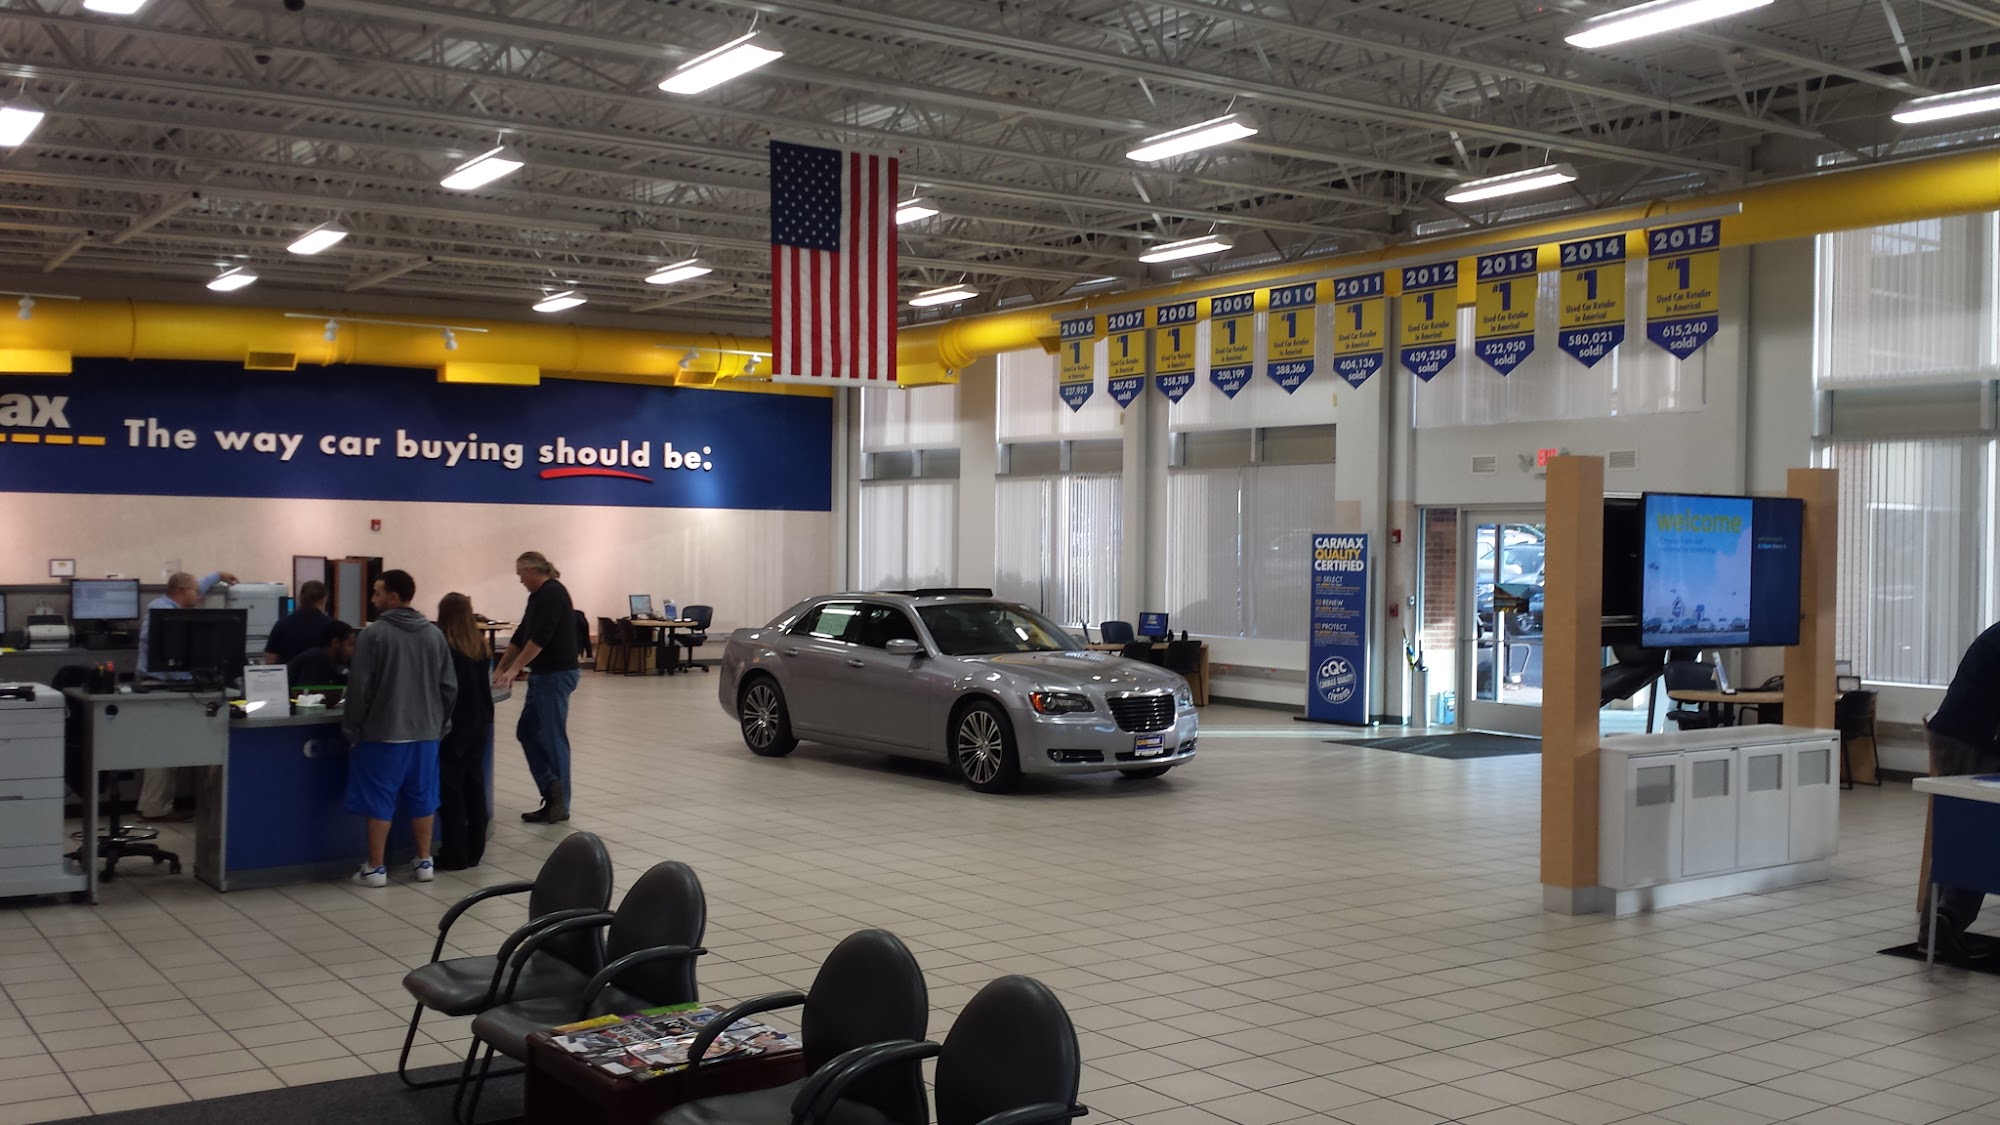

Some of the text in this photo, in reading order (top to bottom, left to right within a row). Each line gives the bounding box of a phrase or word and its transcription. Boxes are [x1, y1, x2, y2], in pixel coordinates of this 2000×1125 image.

[1654, 225, 1714, 250] 2015
[1564, 238, 1619, 263] 2014
[1481, 252, 1533, 275] 2013
[1405, 265, 1454, 286] 2012
[1668, 257, 1690, 290] #1
[1337, 276, 1381, 297] 2011
[1577, 270, 1597, 300] #1
[1271, 287, 1314, 306] 2010
[1493, 282, 1511, 312] #1
[1687, 290, 1711, 300] Retailer
[1160, 305, 1195, 322] 2008
[1214, 296, 1252, 314] 2009
[1417, 293, 1434, 321] #1
[1566, 305, 1580, 313] Used
[1594, 301, 1616, 310] Retailer
[1109, 312, 1142, 329] 2007
[1347, 303, 1362, 330] #1
[1062, 320, 1093, 336] 2006
[1663, 322, 1707, 338] 615,240
[1485, 340, 1525, 355] 522,950
[1568, 331, 1613, 347] 580,021
[1670, 337, 1697, 350] sold!
[1410, 349, 1447, 362] 439,250
[1579, 346, 1603, 358] sold!
[1341, 358, 1374, 371] 404,136
[124, 417, 196, 449] The
[214, 430, 304, 461] way
[319, 434, 381, 456] car
[396, 429, 523, 469] buying
[539, 436, 650, 468] should
[1656, 508, 1742, 533] welcome
[1315, 537, 1364, 549] CARMAX
[1315, 549, 1361, 560] QUALITY
[1314, 560, 1364, 571] CERTIFIED
[1322, 661, 1347, 677] CQC
